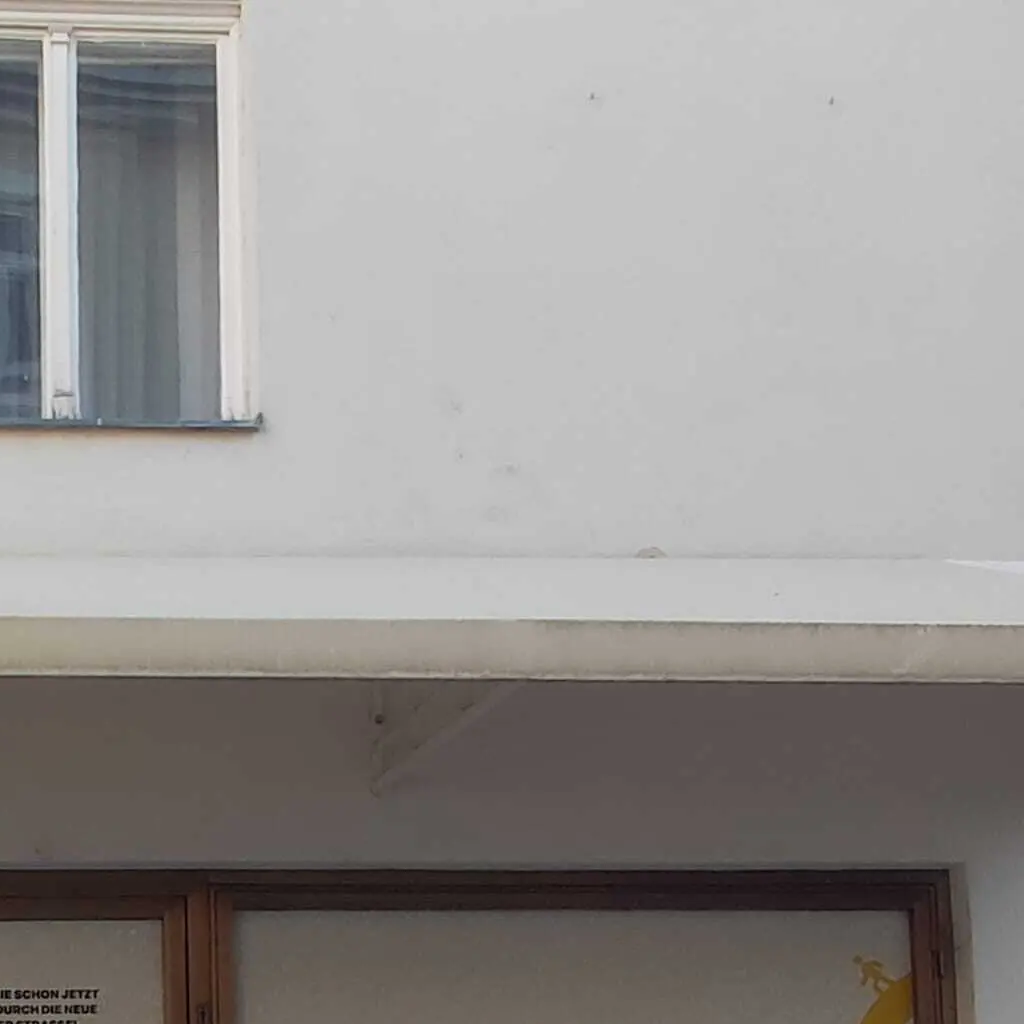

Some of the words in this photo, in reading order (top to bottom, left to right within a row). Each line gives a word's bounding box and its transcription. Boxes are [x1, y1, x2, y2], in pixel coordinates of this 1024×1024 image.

[14, 989, 59, 999] SCHON
[61, 988, 99, 999] JETZT
[41, 1005, 62, 1014] DIE
[64, 1004, 97, 1014] NEUE
